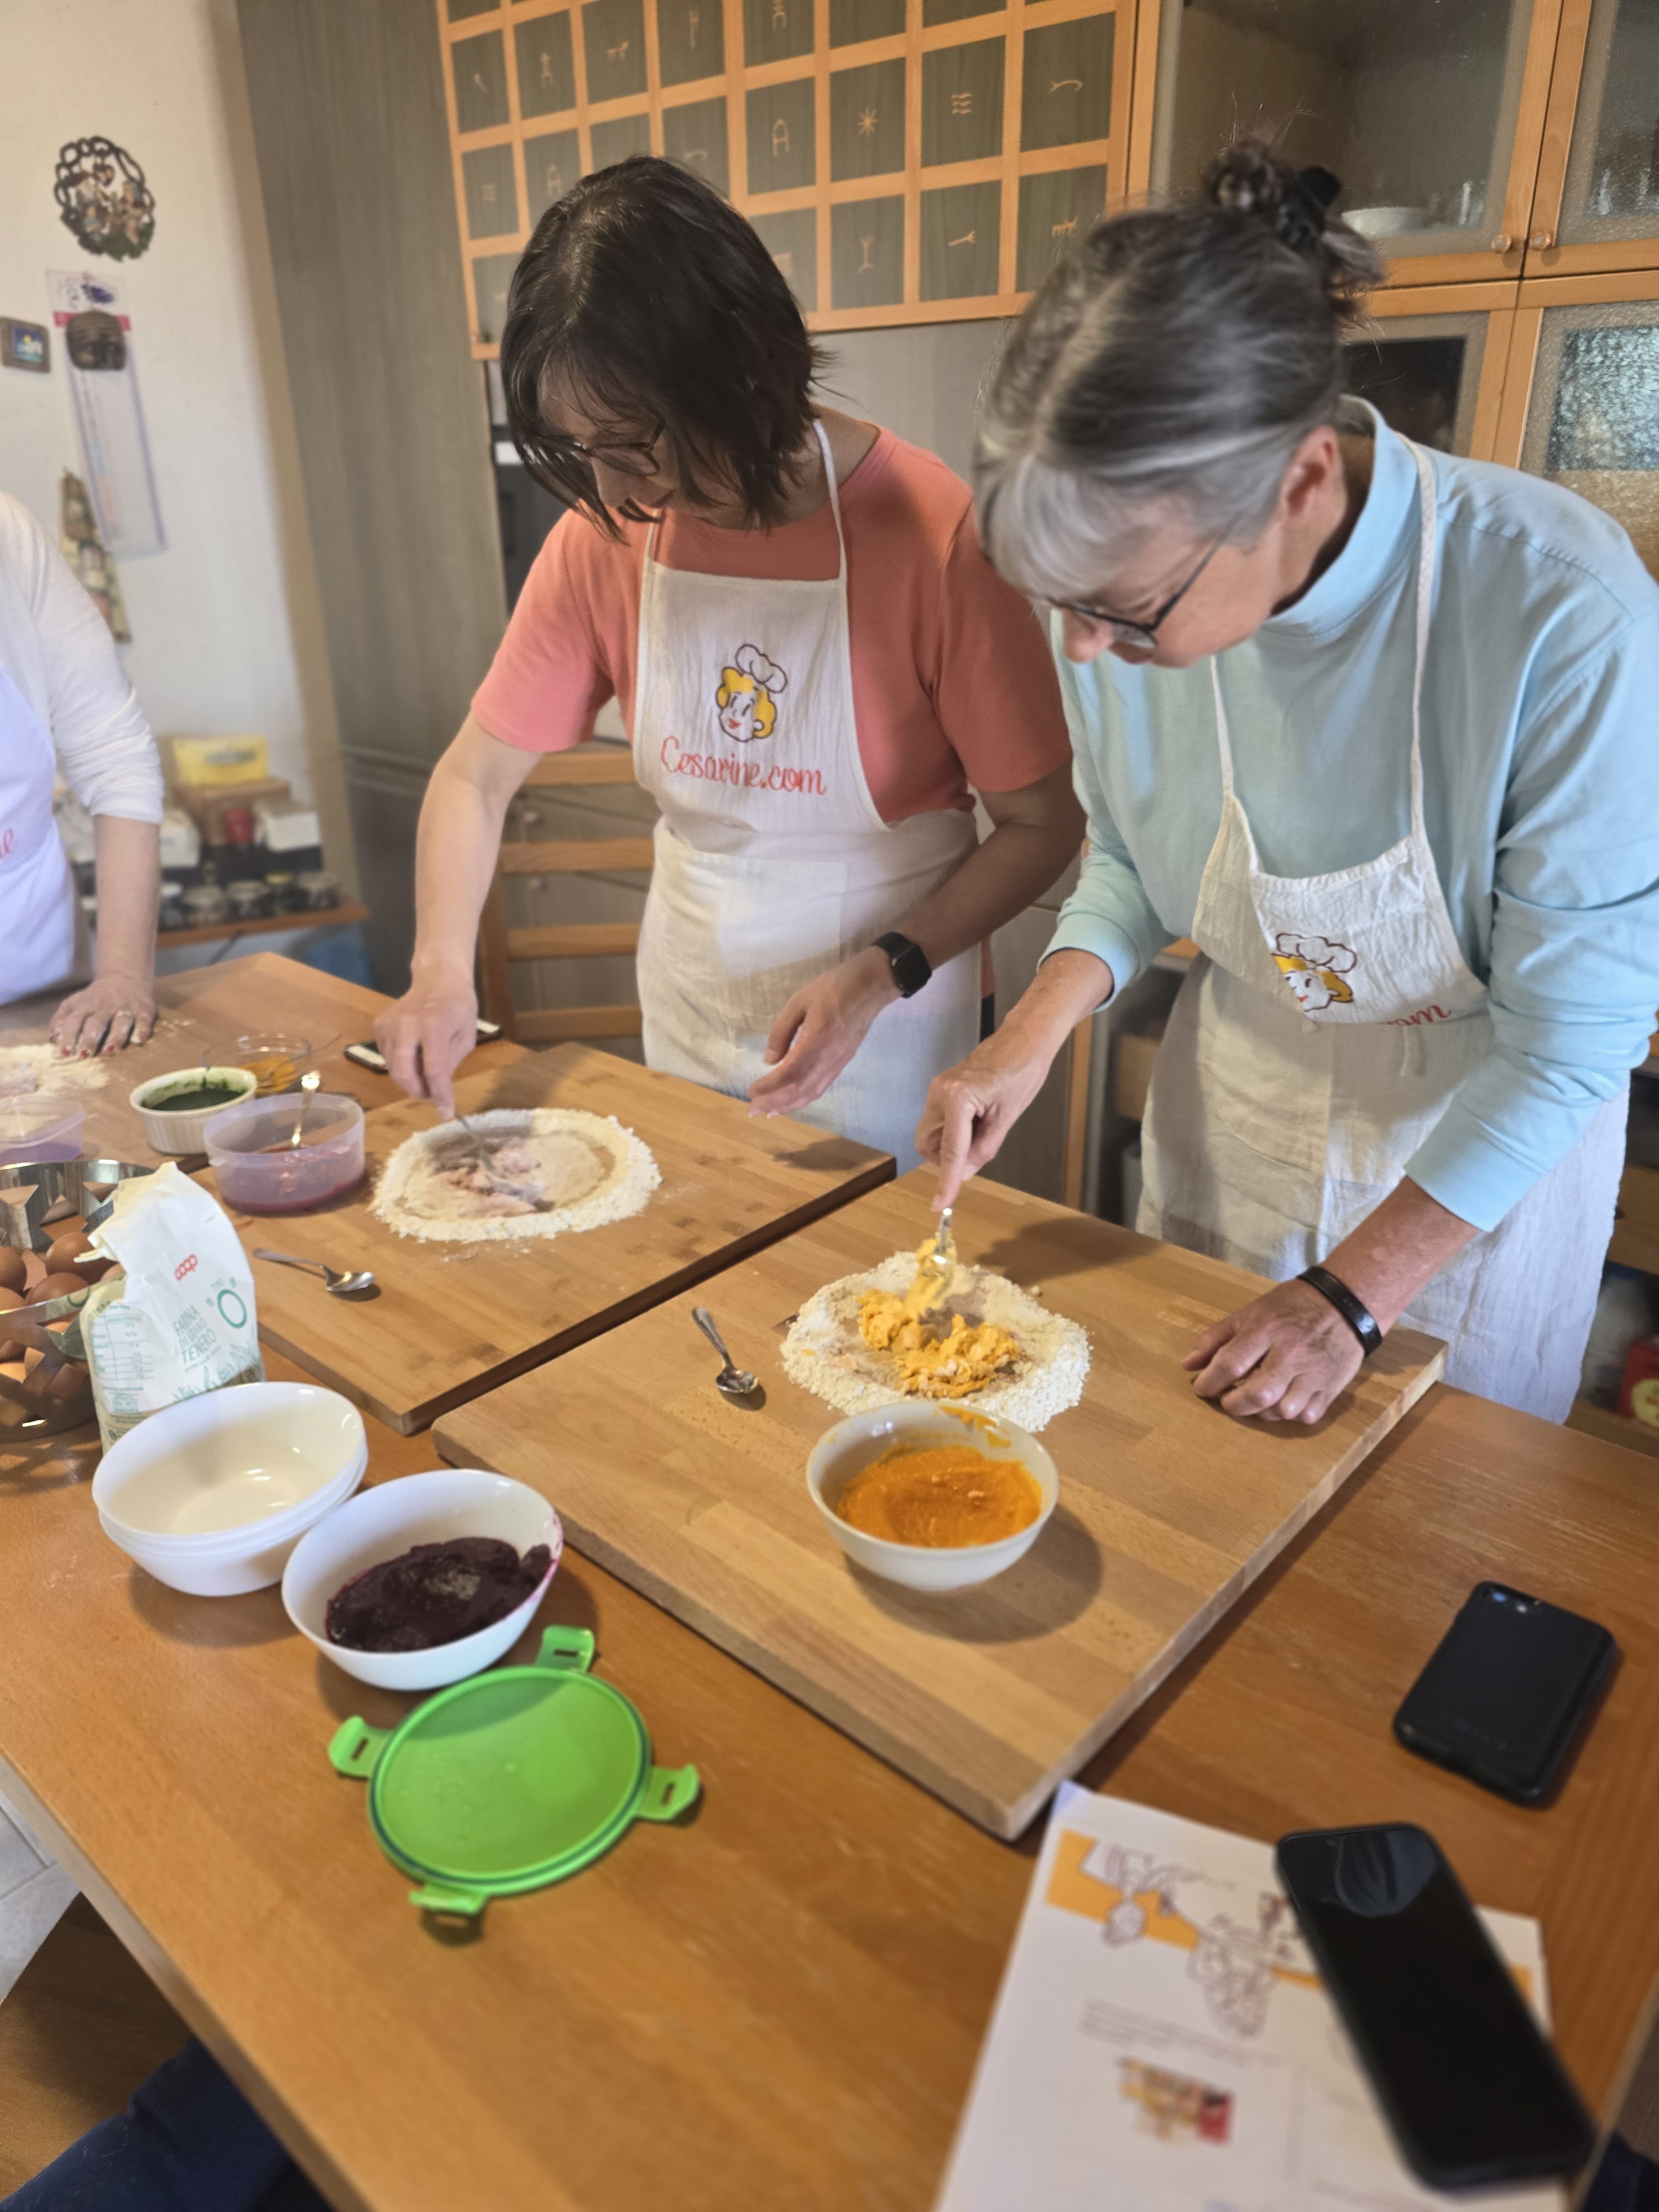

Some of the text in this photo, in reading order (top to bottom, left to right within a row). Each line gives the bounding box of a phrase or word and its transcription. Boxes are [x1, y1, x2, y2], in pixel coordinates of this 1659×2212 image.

[661, 735, 827, 795] Cesarine.com
[175, 1254, 198, 1281] coop
[181, 1328, 217, 1363] TENERO
